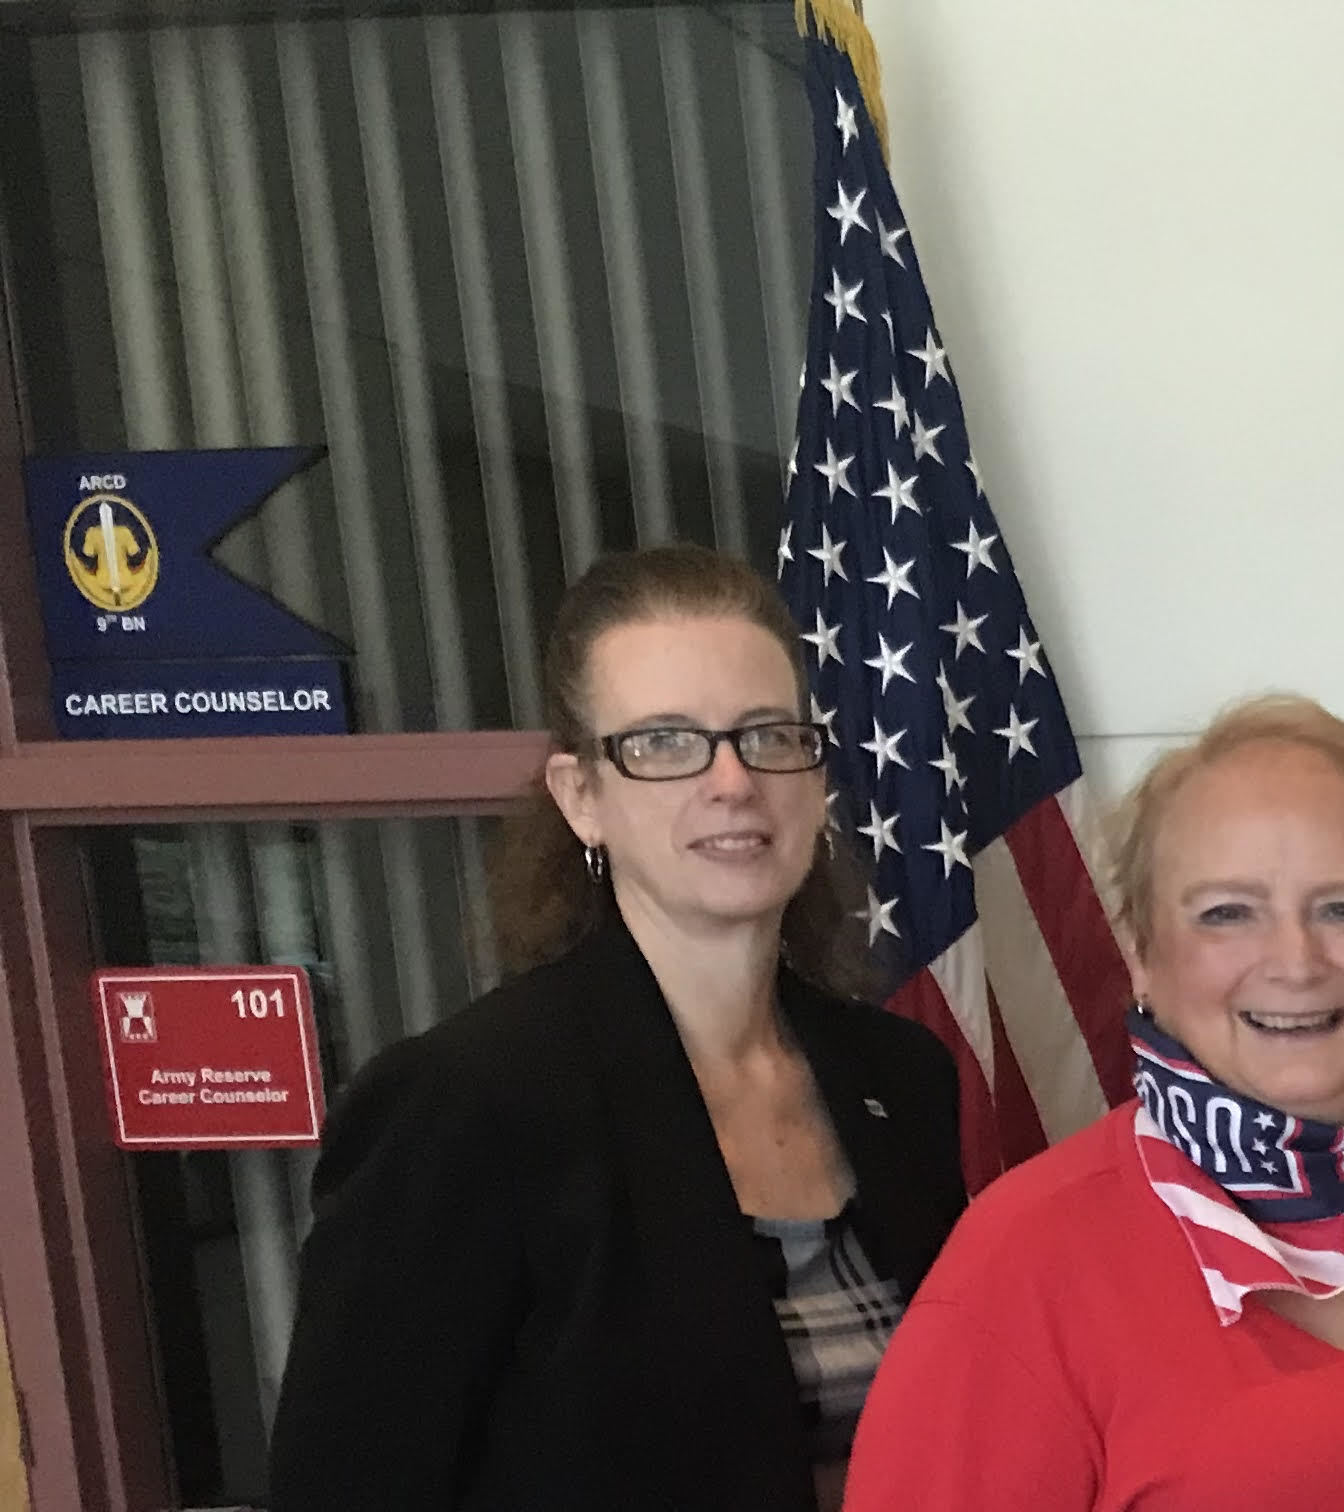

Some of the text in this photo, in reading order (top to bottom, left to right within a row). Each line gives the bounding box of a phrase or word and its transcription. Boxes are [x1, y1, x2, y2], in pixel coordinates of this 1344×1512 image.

[79, 474, 126, 491] ARCD
[121, 614, 146, 632] BN
[66, 689, 331, 716] CAREER COUNSELOR
[230, 989, 286, 1019] 101
[151, 1068, 272, 1087] Army Reserve
[138, 1087, 289, 1105] Career Counselor
